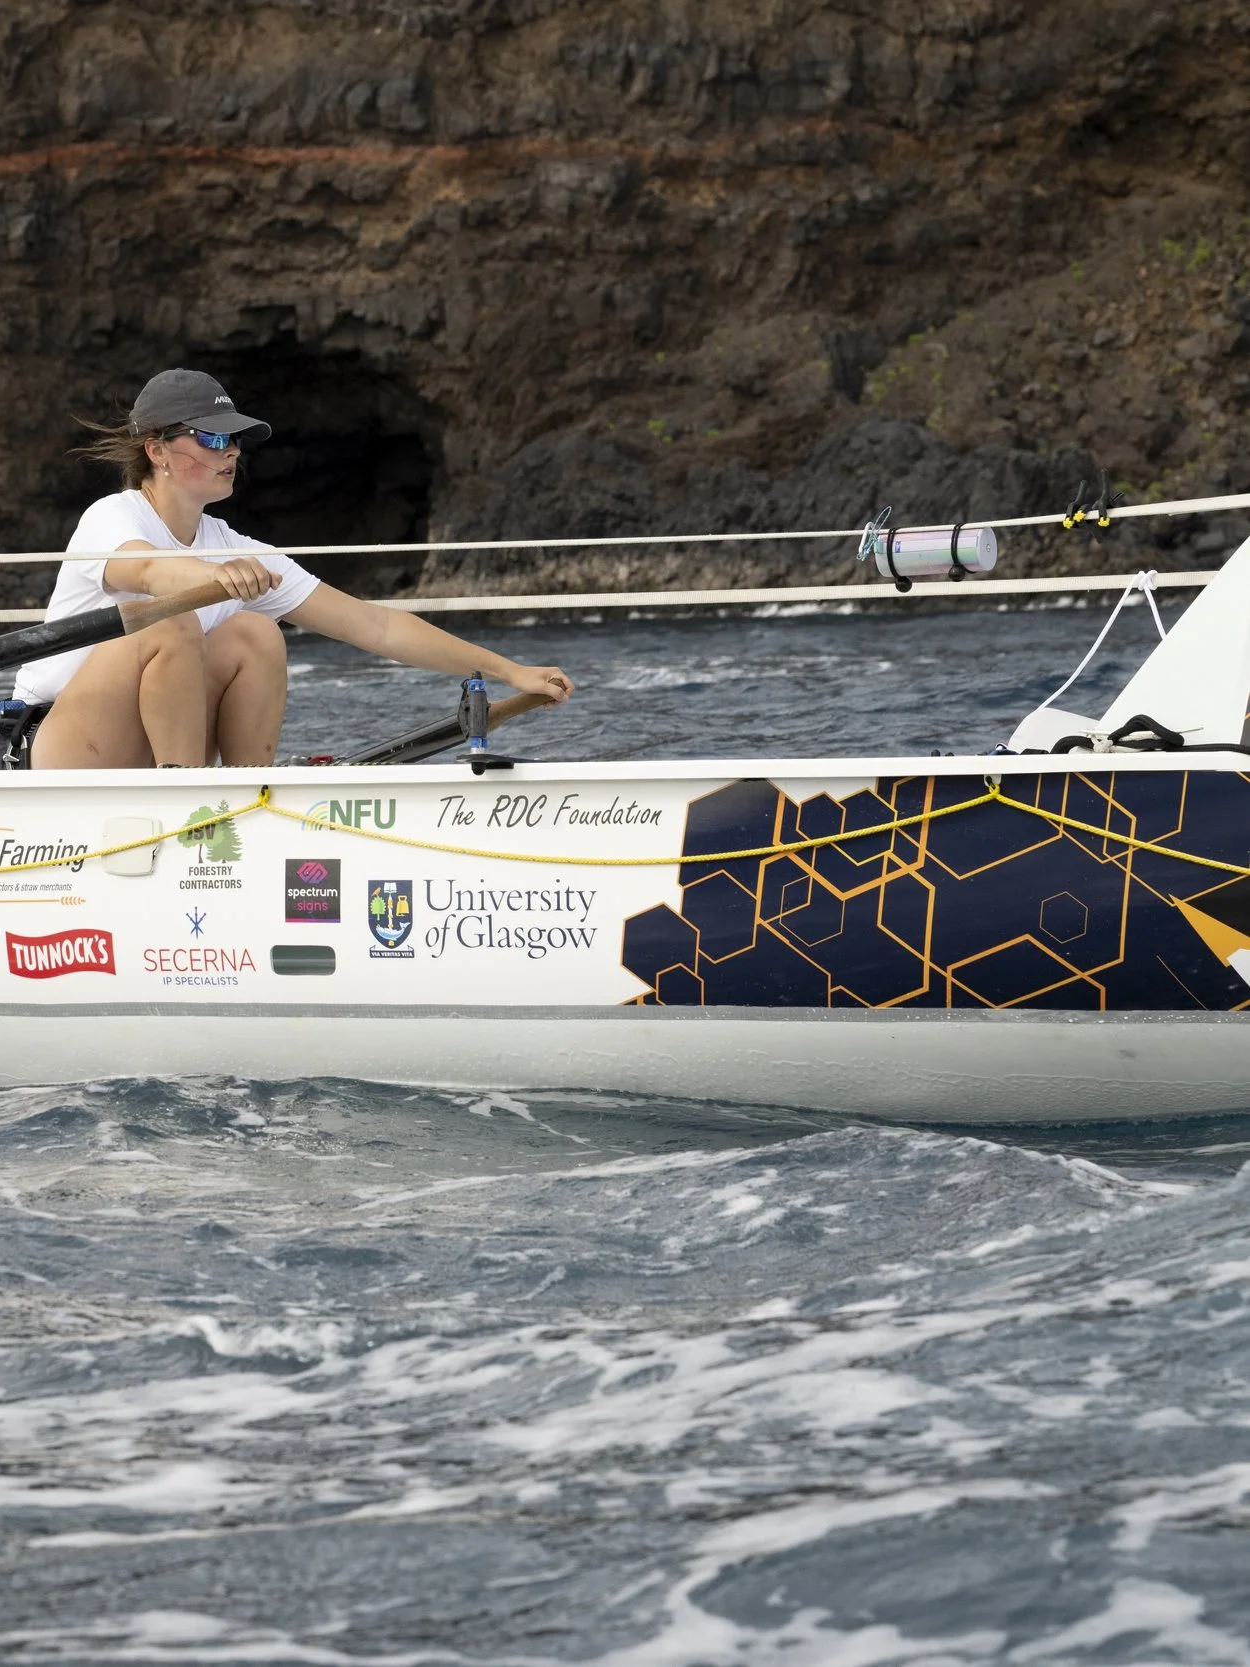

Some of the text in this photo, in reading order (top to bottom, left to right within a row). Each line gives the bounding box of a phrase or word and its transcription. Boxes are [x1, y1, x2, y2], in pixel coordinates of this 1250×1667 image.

[329, 798, 397, 830] NFU
[437, 793, 662, 828] The RDC Foundation
[188, 866, 232, 876] FORESTRY
[15, 883, 20, 891] &
[39, 883, 73, 891] merchants
[179, 879, 242, 890] CONTRACTORS
[287, 887, 338, 899] spectrum
[297, 900, 328, 914] signs
[423, 879, 597, 922] University
[425, 914, 598, 959] of Glasgow
[11, 934, 109, 971] TUNNOCK'S
[143, 948, 256, 972] SECERNA
[163, 976, 238, 985] IP SPECIALISTS
